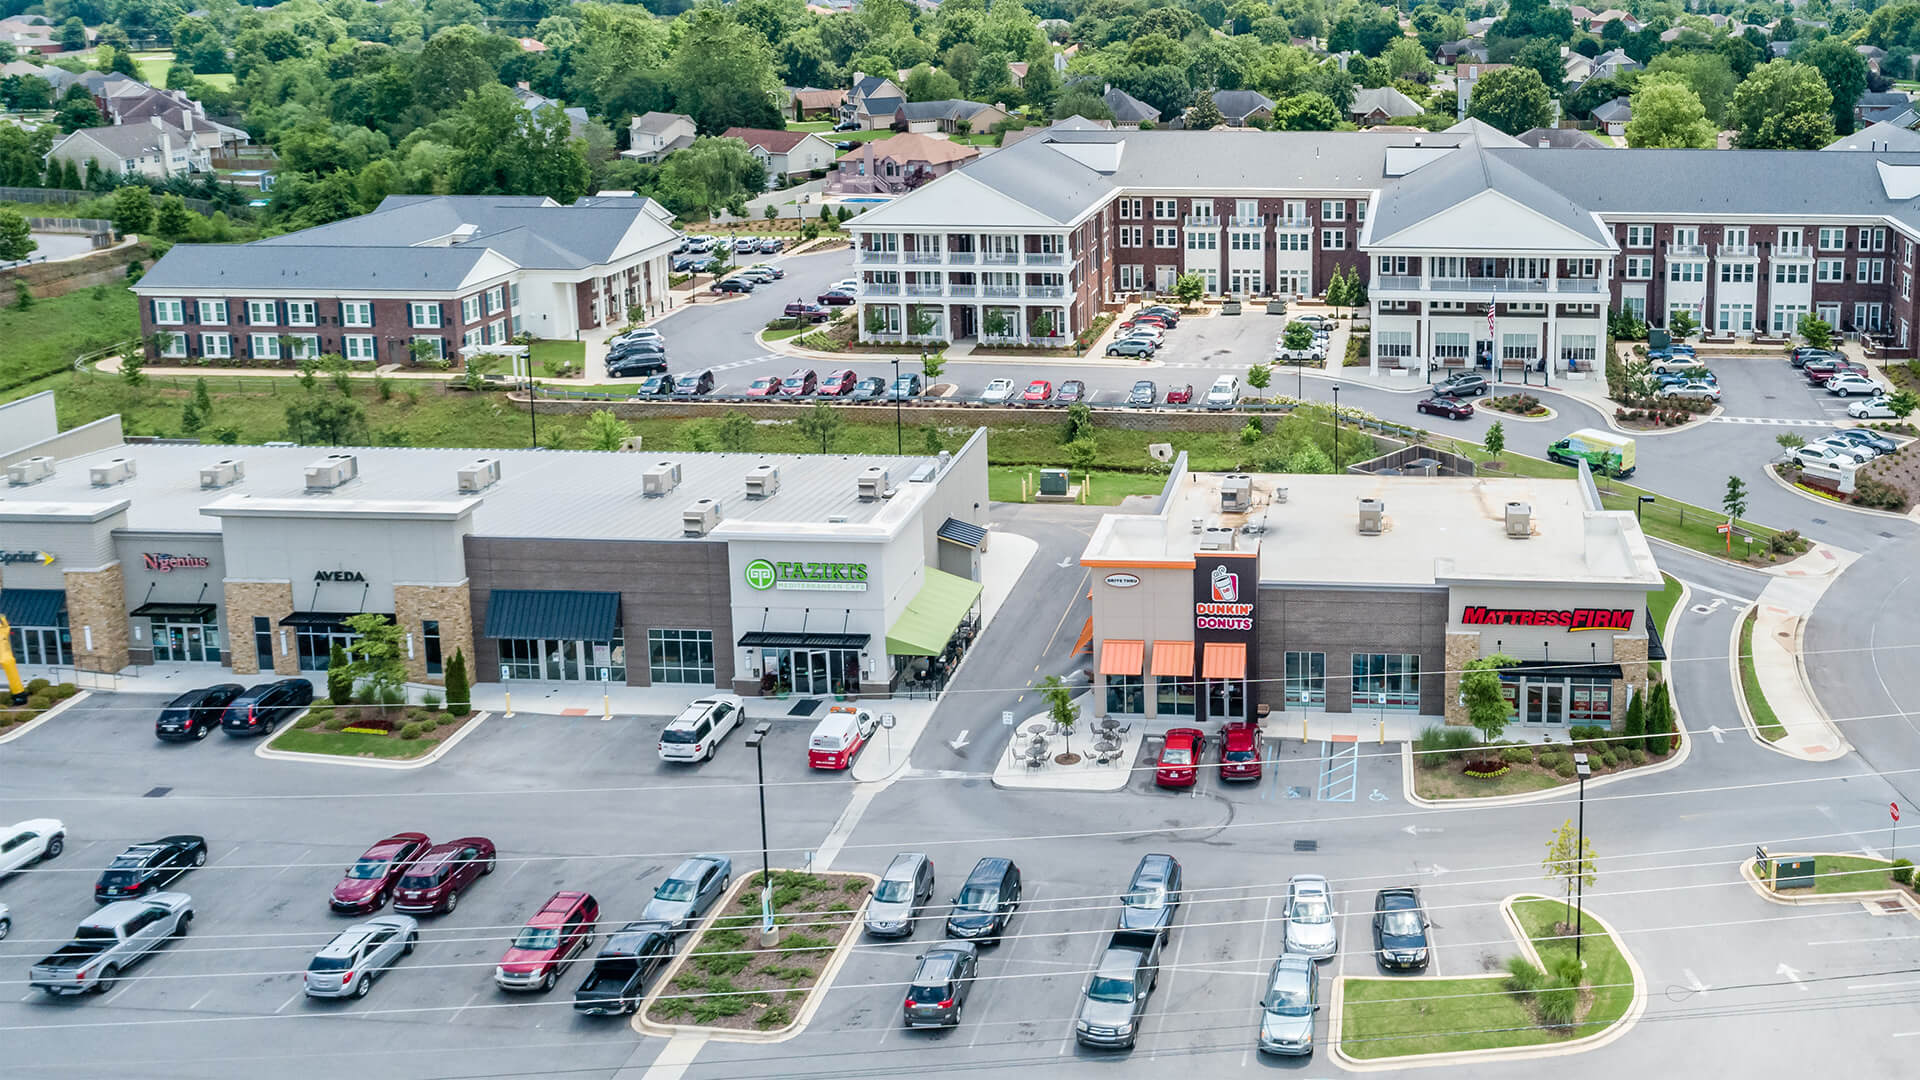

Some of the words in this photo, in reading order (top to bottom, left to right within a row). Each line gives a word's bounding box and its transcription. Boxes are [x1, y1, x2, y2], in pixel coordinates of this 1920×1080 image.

[314, 570, 366, 582] AVEDA
[1196, 603, 1253, 616] DUNKIN'
[1197, 617, 1252, 630] DONUTS
